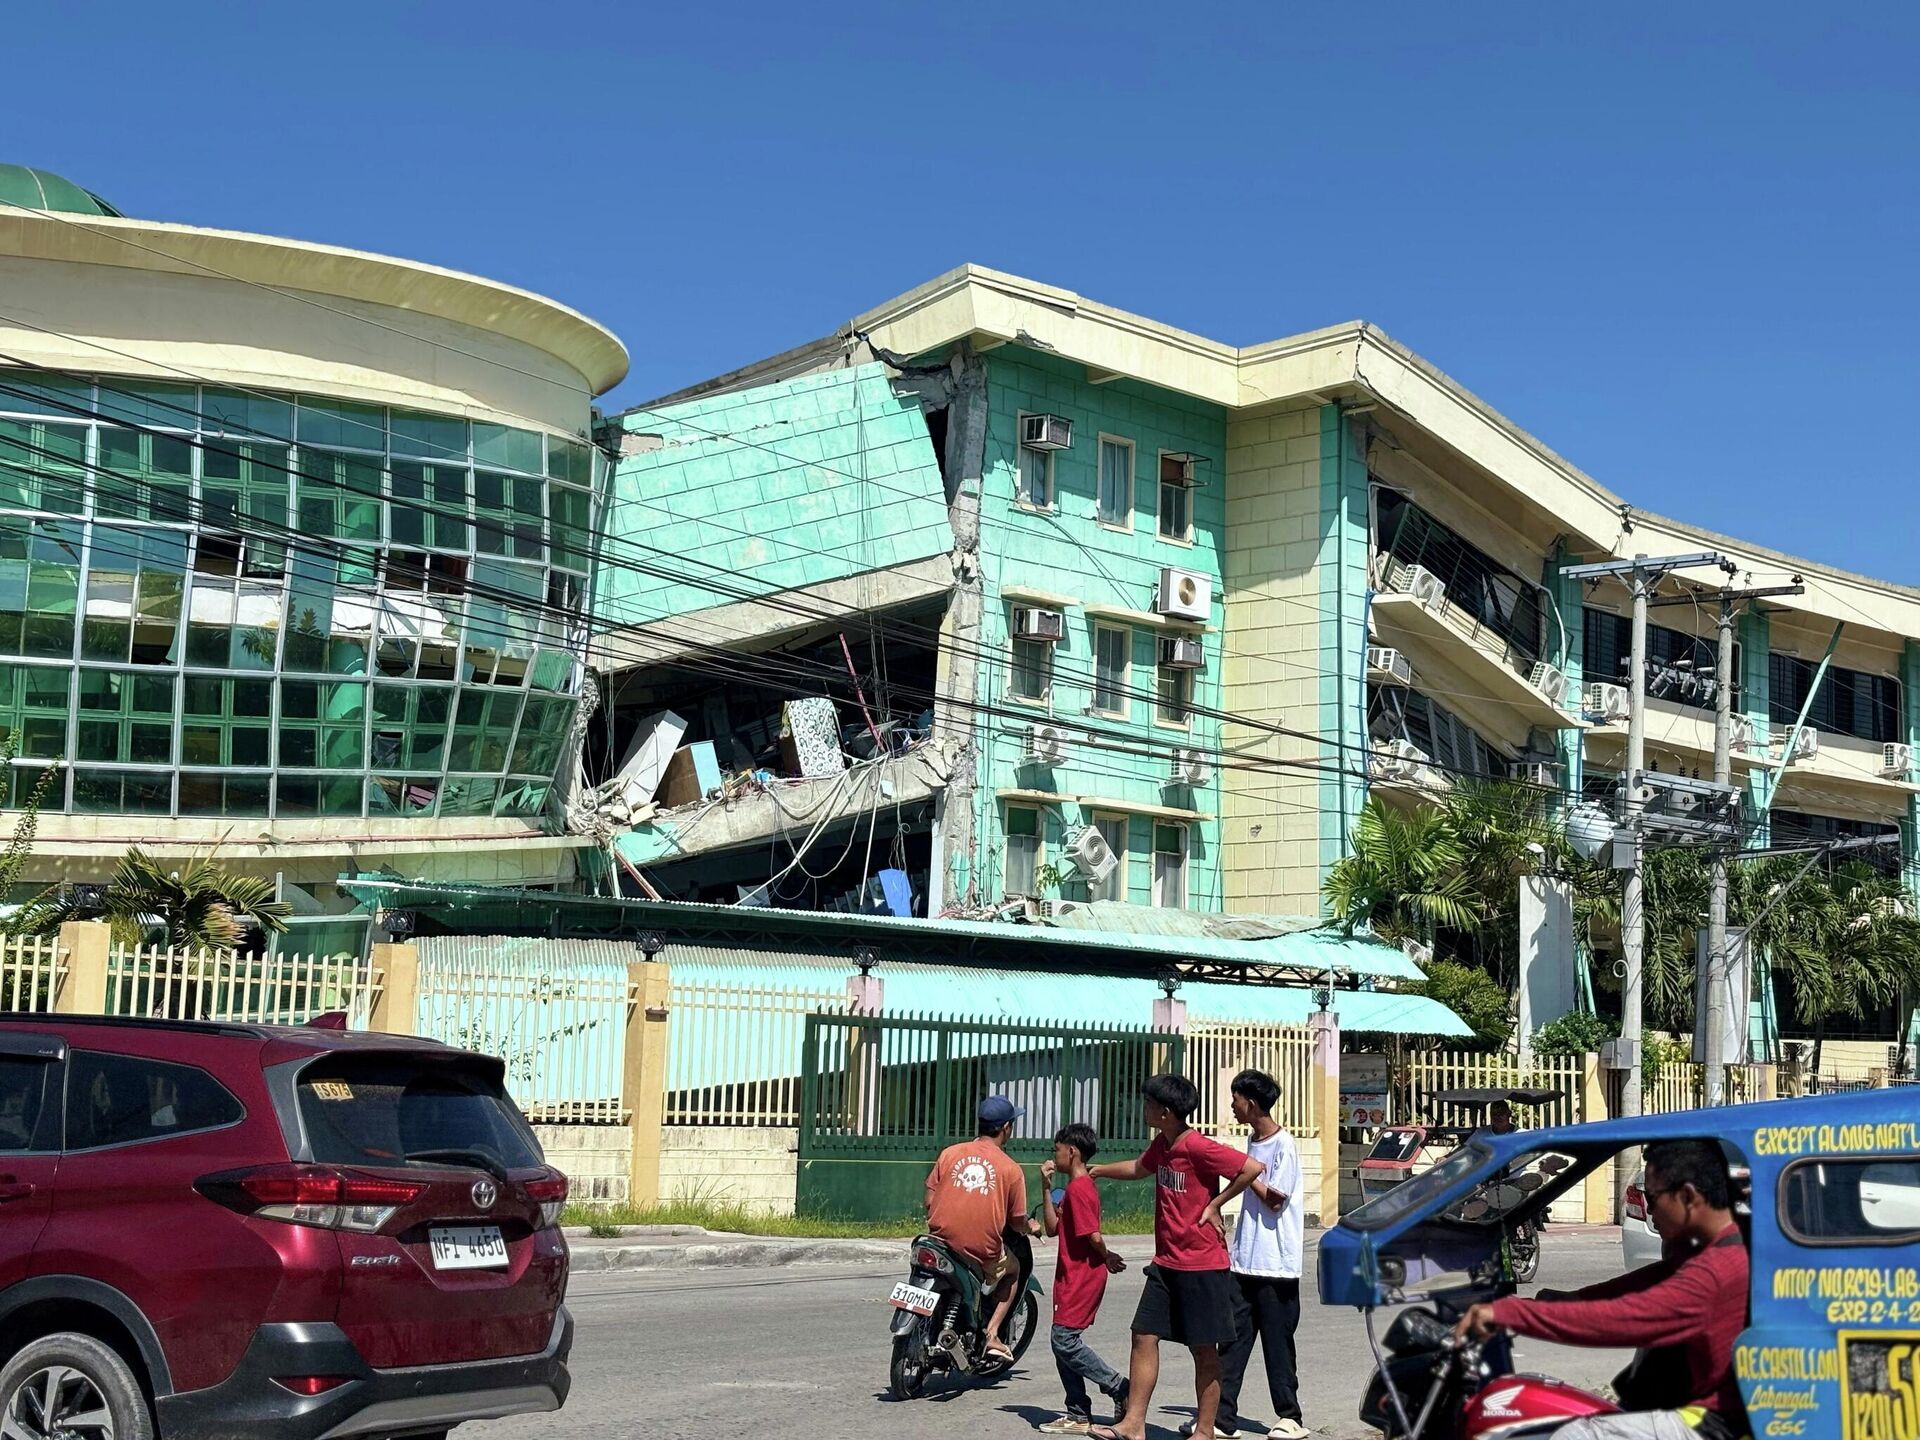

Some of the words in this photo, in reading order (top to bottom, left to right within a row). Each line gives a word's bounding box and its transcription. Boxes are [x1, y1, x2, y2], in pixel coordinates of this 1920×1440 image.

[1755, 1126, 1816, 1155] EXCEPT
[1818, 1124, 1874, 1152] ALONG
[1875, 1122, 1920, 1151] NAT'L
[953, 1157, 966, 1170] OFF
[967, 1155, 982, 1164] THE
[982, 1158, 997, 1180] WALL
[469, 1234, 504, 1258] 4650
[352, 1254, 401, 1265] Rush
[1774, 1267, 1816, 1299] MTOP
[1482, 1409, 1523, 1417] HONDA
